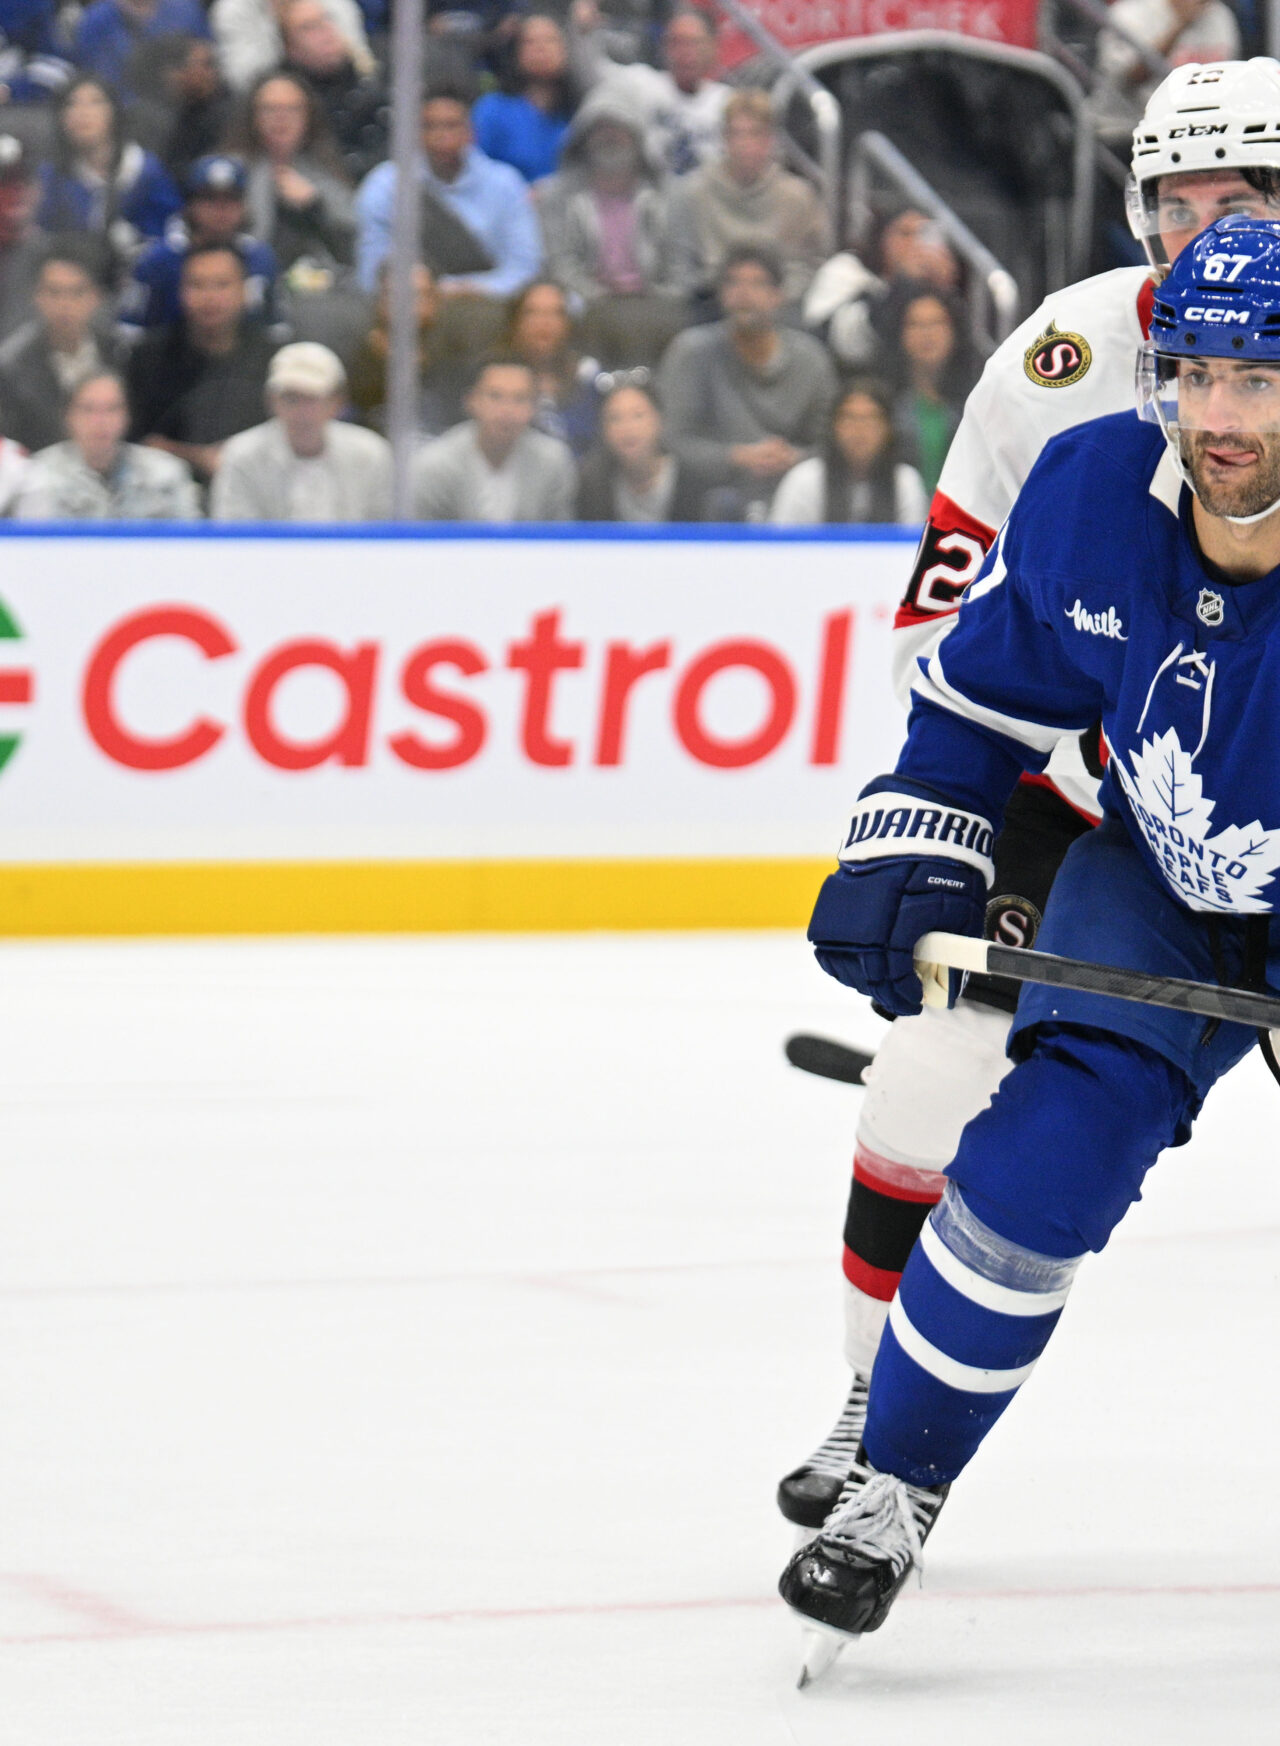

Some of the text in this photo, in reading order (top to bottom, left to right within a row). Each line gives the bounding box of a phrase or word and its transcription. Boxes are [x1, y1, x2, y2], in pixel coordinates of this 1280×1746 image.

[1168, 123, 1229, 139] CCM
[1203, 253, 1252, 282] 67
[1184, 306, 1250, 324] CCM
[1034, 343, 1079, 378] S
[907, 524, 987, 612] 2
[1203, 600, 1219, 616] NHL
[80, 602, 855, 772] Castrol
[927, 876, 966, 889] COVERT
[994, 909, 1028, 947] S
